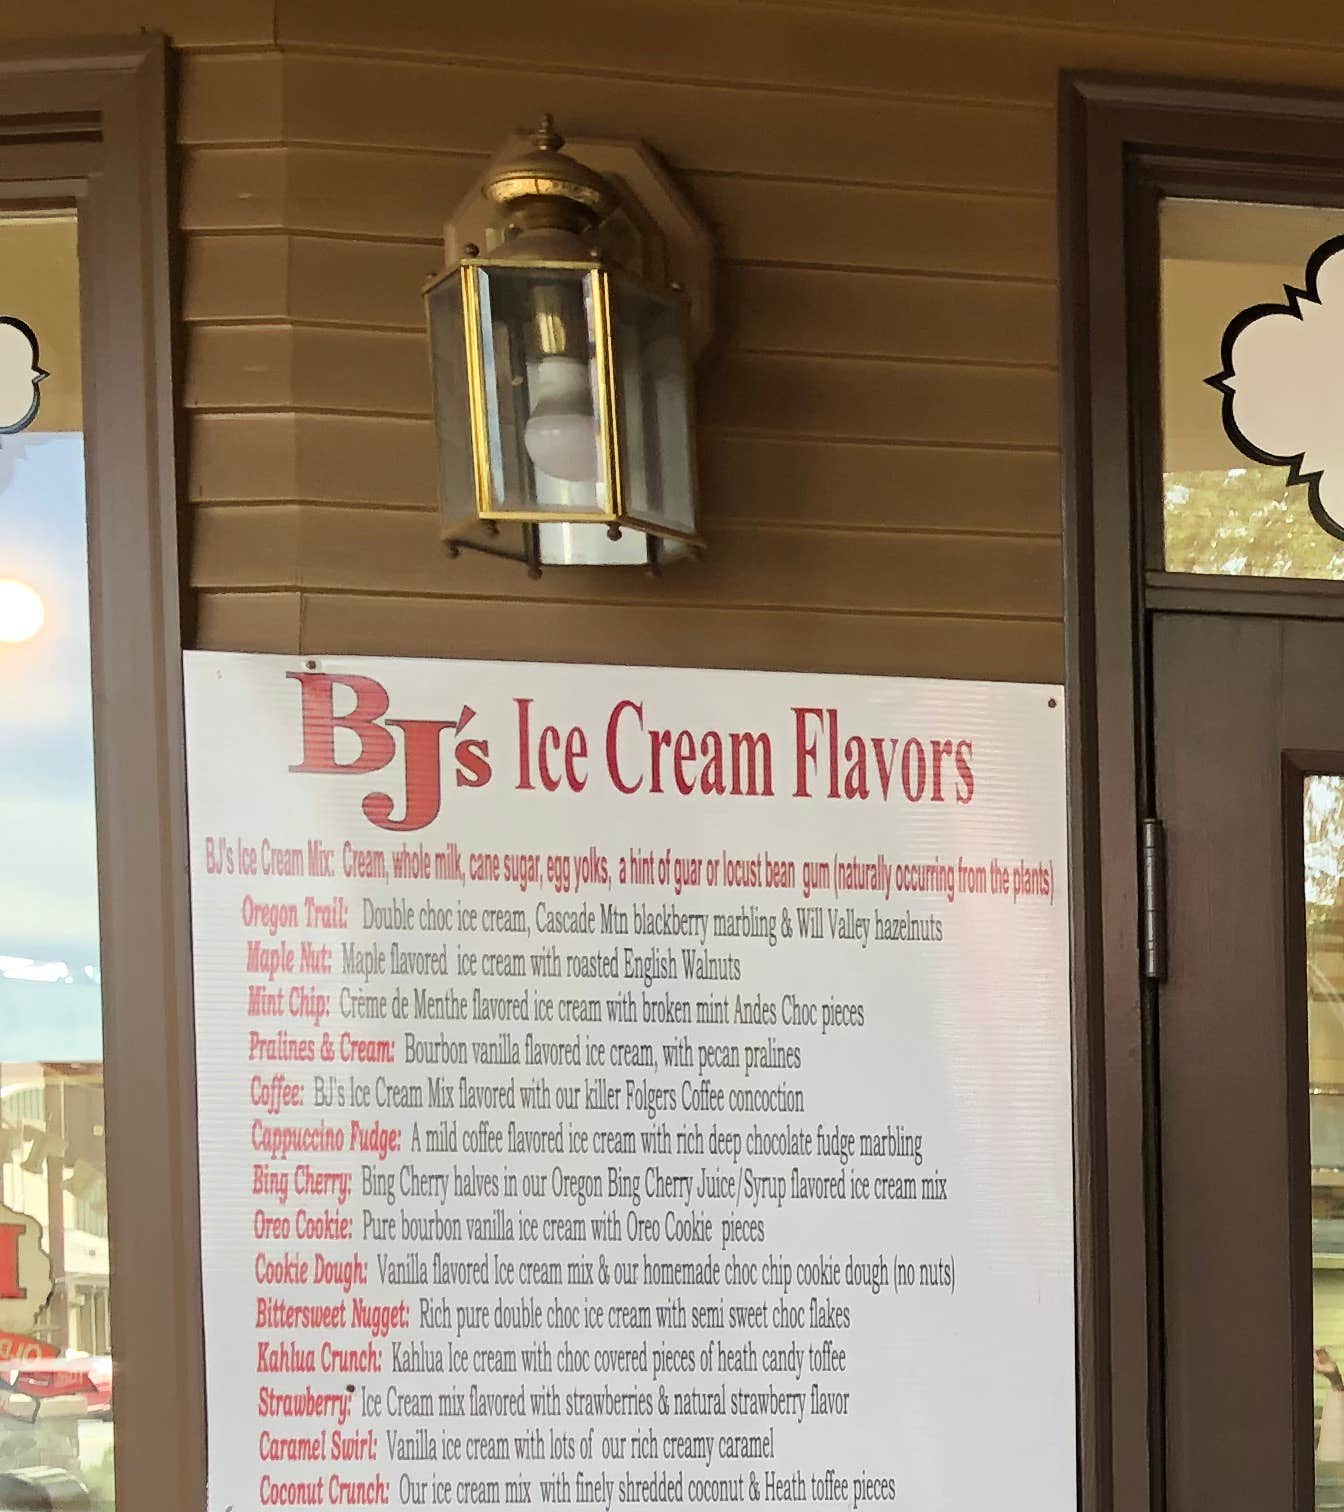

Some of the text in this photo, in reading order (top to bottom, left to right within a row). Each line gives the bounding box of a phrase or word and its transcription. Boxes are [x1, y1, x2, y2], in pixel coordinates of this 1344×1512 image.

[286, 671, 975, 832] BJ's Ice Cream Flavors
[241, 894, 944, 950] Oregon Trail: Double choc ice cream, Cascade Mtn blackberry marbling & Will Valley hazelnuts
[253, 1207, 766, 1252] Oreo Cookie: Pure bourbon vanilla ice cream with Oreo Cookie pieces
